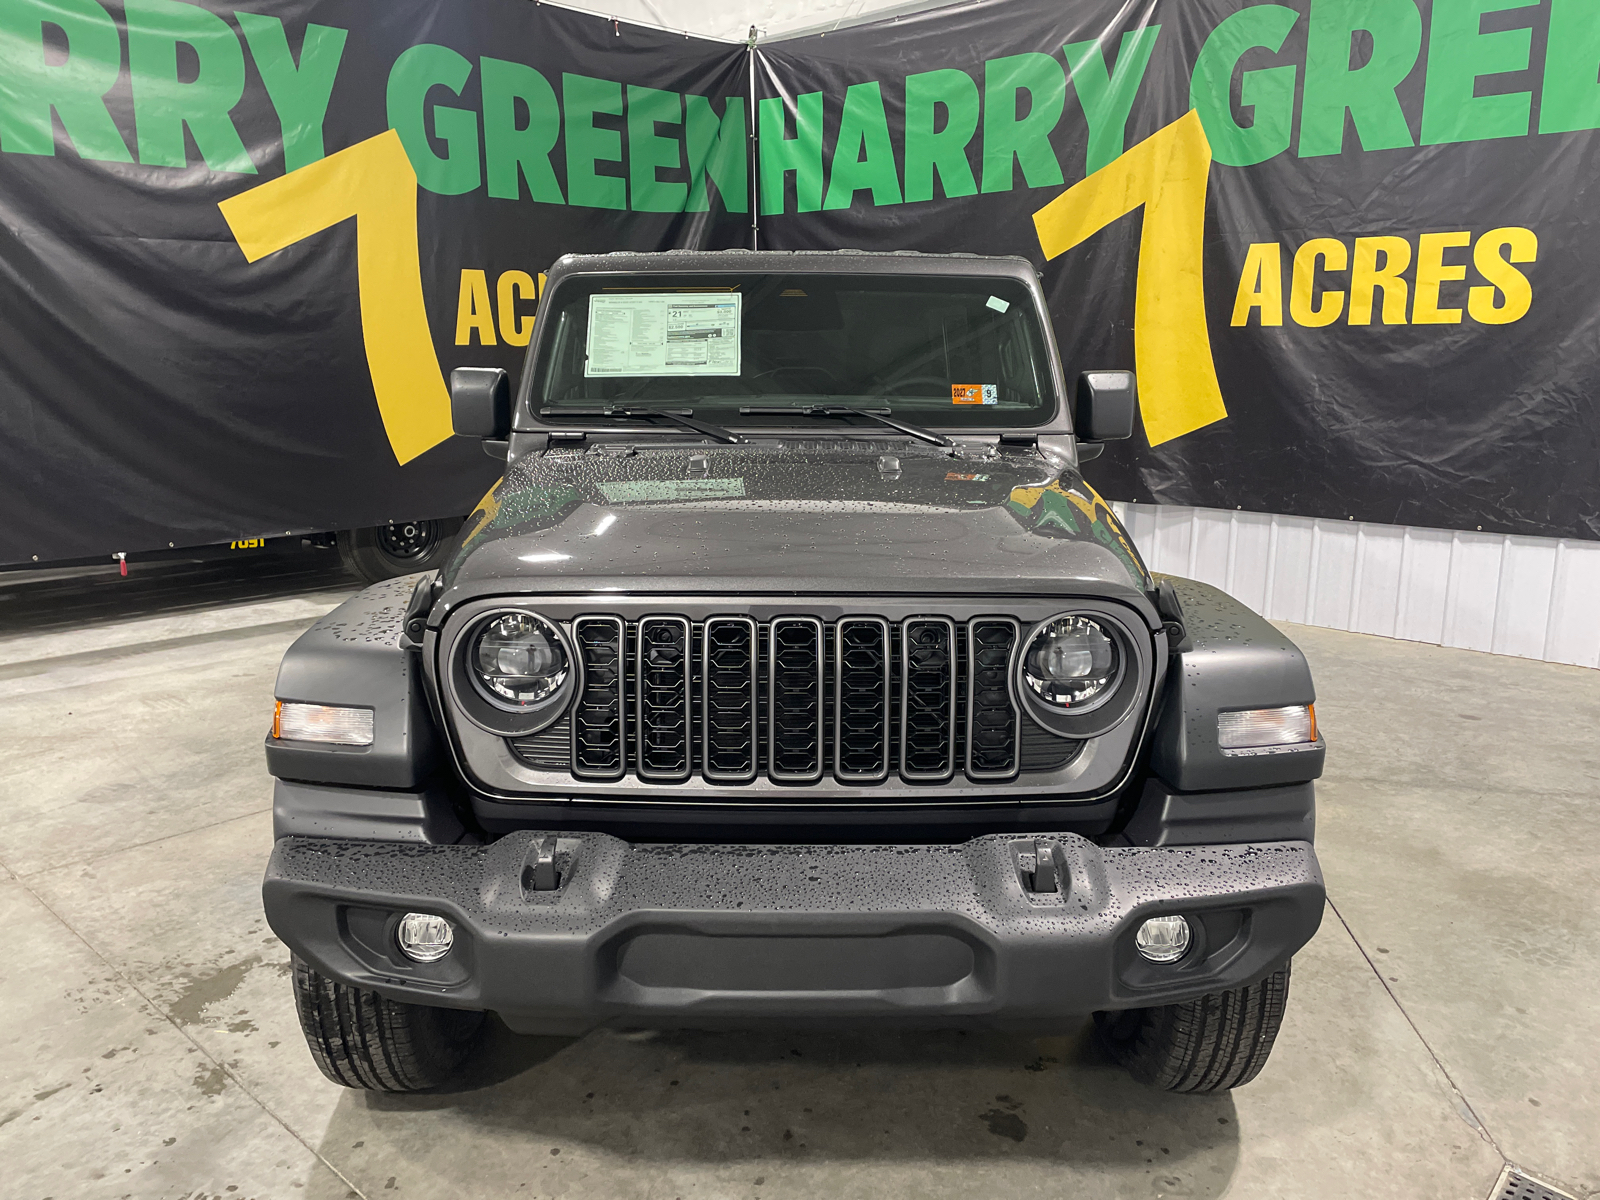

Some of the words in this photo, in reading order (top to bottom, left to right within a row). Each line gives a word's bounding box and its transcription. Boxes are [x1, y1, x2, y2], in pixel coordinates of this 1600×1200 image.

[387, 43, 748, 213] GREEN
[760, 26, 1160, 216] HARRY
[218, 128, 456, 466] 7
[455, 269, 548, 347] AC
[1032, 108, 1227, 447] 7
[1231, 227, 1538, 328] ACRES
[986, 388, 992, 398] 9
